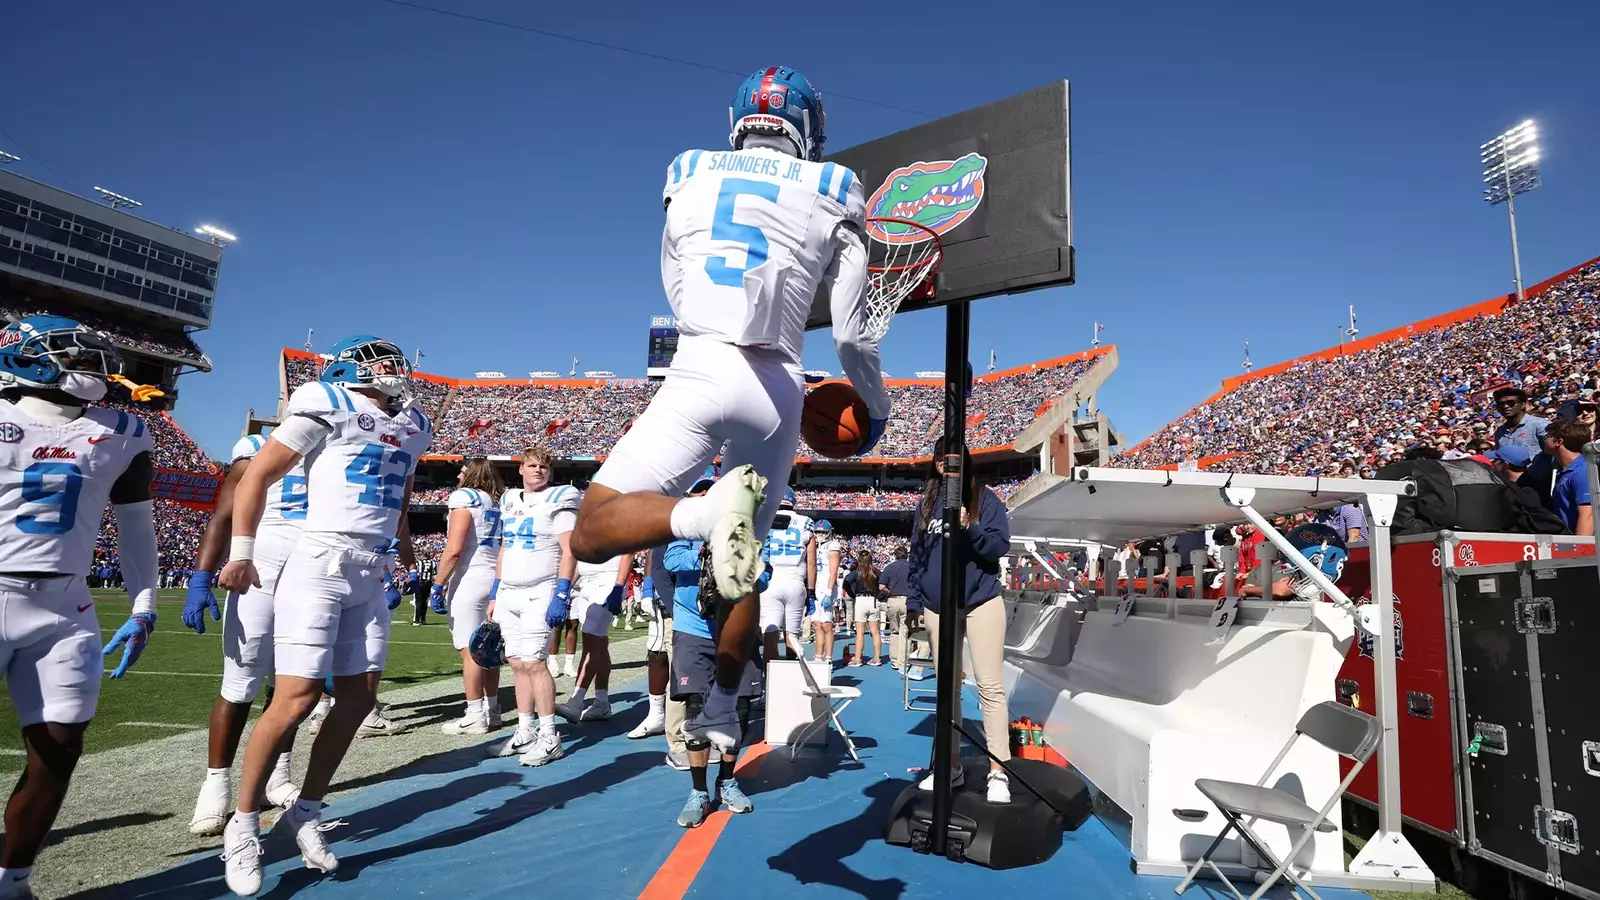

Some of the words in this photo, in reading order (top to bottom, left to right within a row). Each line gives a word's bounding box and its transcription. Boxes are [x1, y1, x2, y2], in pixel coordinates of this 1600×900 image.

[708, 153, 780, 176] SAUNDERS
[782, 162, 803, 183] JR.
[704, 177, 781, 288] 5
[652, 317, 670, 326] BEN
[358, 415, 373, 429] SEC
[32, 446, 49, 459] Ole
[49, 446, 77, 459] Miss
[345, 443, 412, 510] 42
[15, 462, 83, 534] 9
[503, 517, 537, 549] 54
[1431, 548, 1441, 567] 8
[1459, 544, 1475, 561] Ole
[1523, 545, 1537, 561] 8
[423, 562, 431, 572] F
